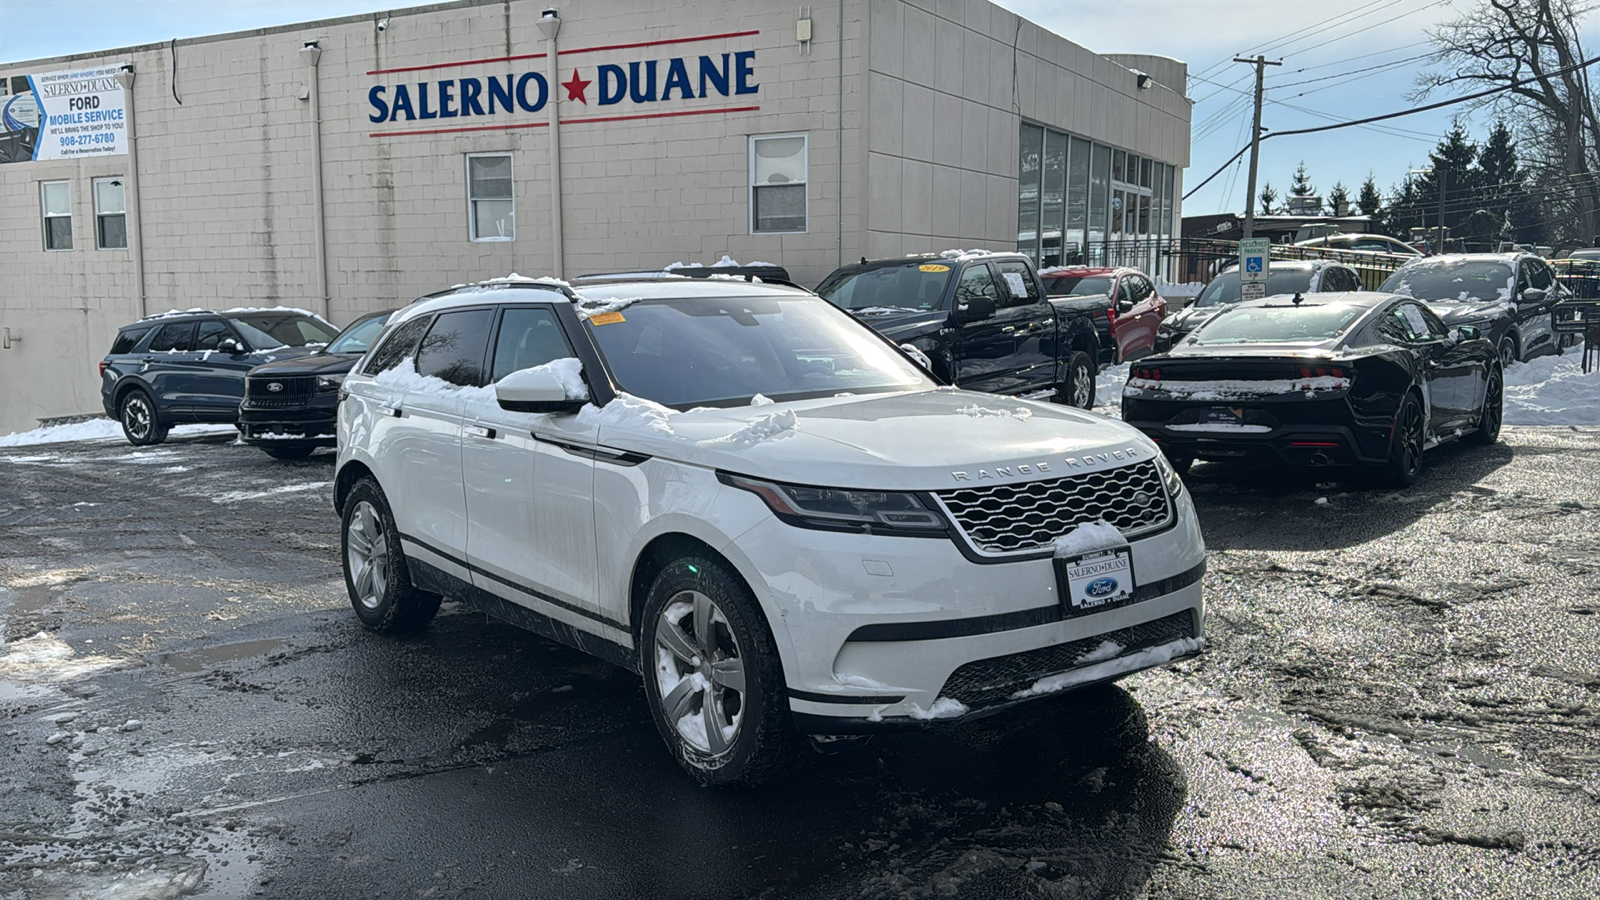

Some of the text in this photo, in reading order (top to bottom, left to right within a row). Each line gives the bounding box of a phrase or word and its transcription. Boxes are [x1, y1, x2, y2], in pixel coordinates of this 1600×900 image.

[105, 67, 116, 75] NEED
[44, 78, 120, 97] SALERNO DUANE
[368, 51, 760, 123] SALERNO DUANE
[69, 95, 100, 111] FORD
[49, 109, 124, 126] MOBILE SERVICE
[65, 126, 79, 134] BRING
[60, 132, 115, 147] 908-277-6780
[951, 447, 1138, 482] RANGE ROVER
[1068, 559, 1128, 578] SALERNO DUANE
[1092, 580, 1112, 594] Ford
[1080, 600, 1106, 609] SALERNO
